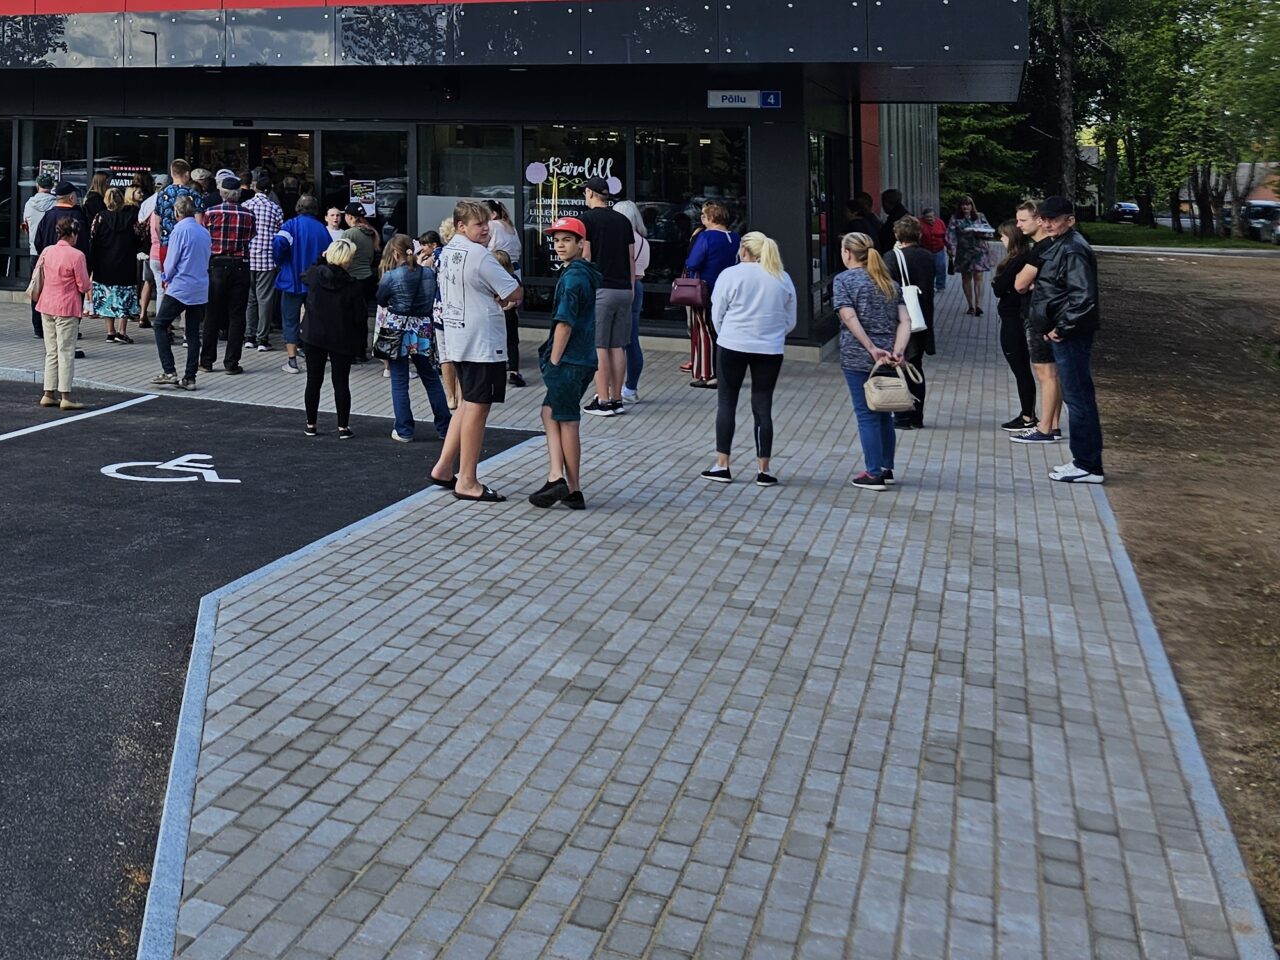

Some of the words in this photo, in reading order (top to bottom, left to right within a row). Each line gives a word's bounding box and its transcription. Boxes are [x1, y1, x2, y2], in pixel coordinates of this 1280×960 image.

[721, 94, 747, 104] Põllu
[767, 94, 776, 105] 4
[544, 156, 614, 179] Kärolill
[110, 179, 133, 187] AVATU
